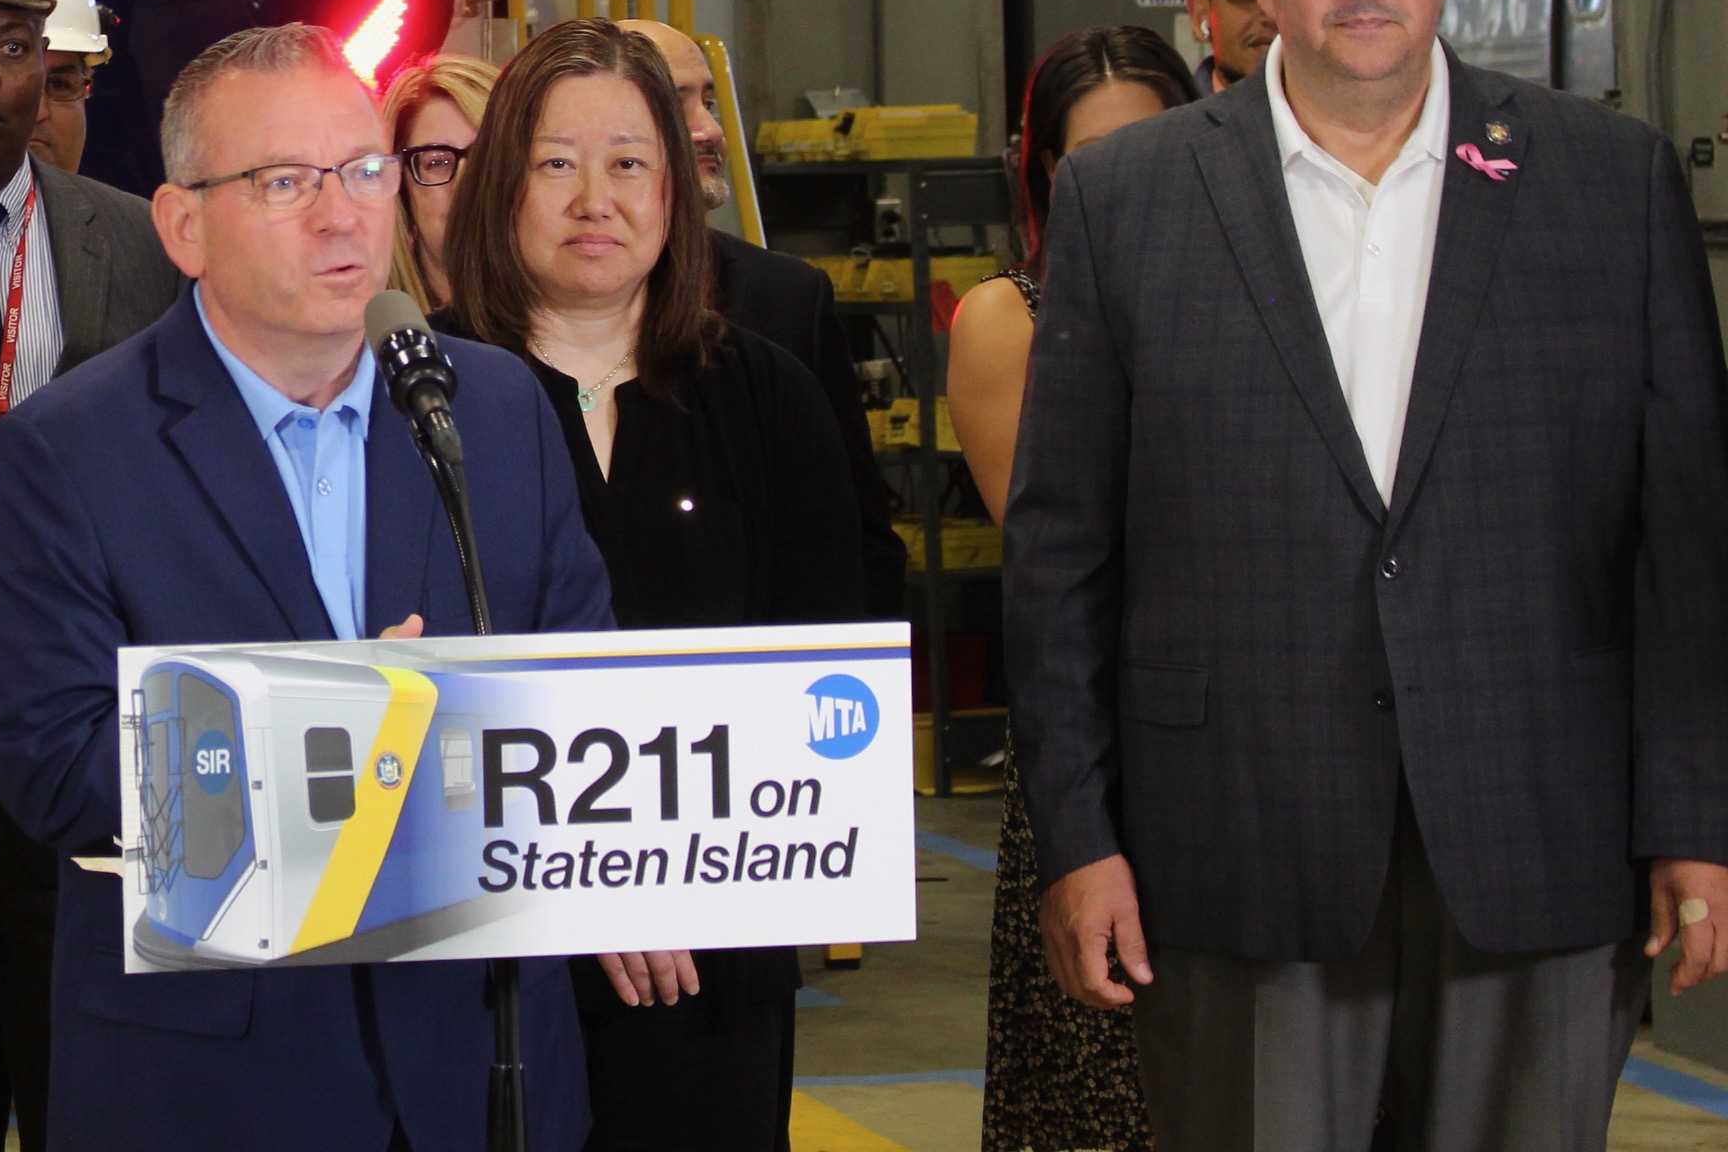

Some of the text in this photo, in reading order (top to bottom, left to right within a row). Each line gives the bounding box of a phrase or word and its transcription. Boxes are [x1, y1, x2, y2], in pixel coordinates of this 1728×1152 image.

[0, 253, 24, 401] VISITOR VISITOR VISITOR
[805, 694, 867, 743] MTA
[196, 749, 231, 775] SIR
[482, 724, 731, 829] R211
[750, 778, 822, 819] on
[478, 827, 860, 894] Staten Island
